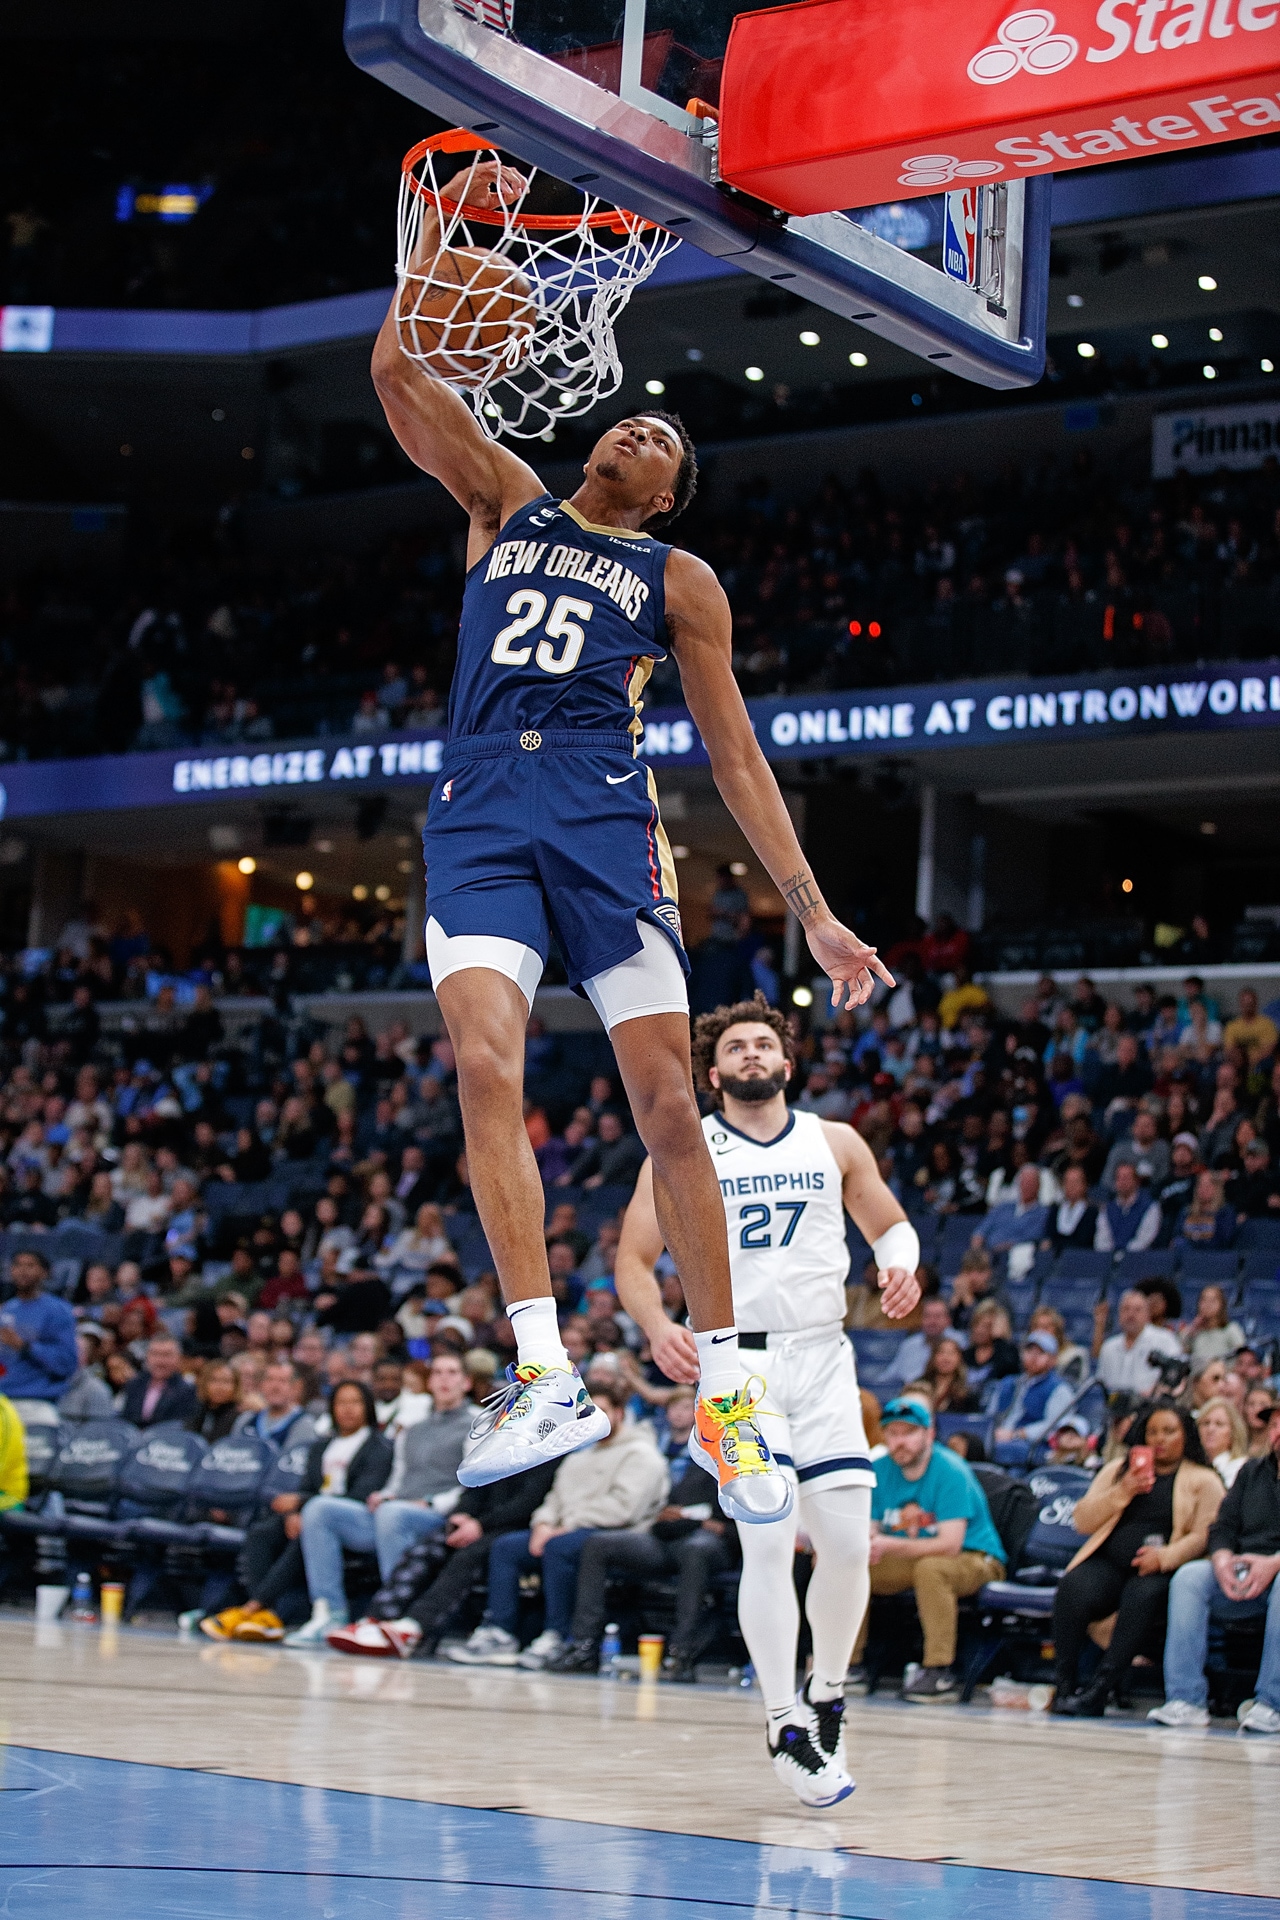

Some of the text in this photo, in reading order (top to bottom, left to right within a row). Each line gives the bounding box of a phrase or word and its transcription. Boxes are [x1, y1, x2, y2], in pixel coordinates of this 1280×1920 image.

[947, 248, 964, 275] NBA
[483, 540, 650, 622] NEW ORLEANS
[491, 588, 594, 674] 25
[771, 702, 915, 746] ONLINE
[924, 698, 976, 735] AT
[173, 740, 444, 792] ENERGIZE AT THE
[719, 1172, 825, 1197] MEMPHIS
[739, 1201, 808, 1249] 27
